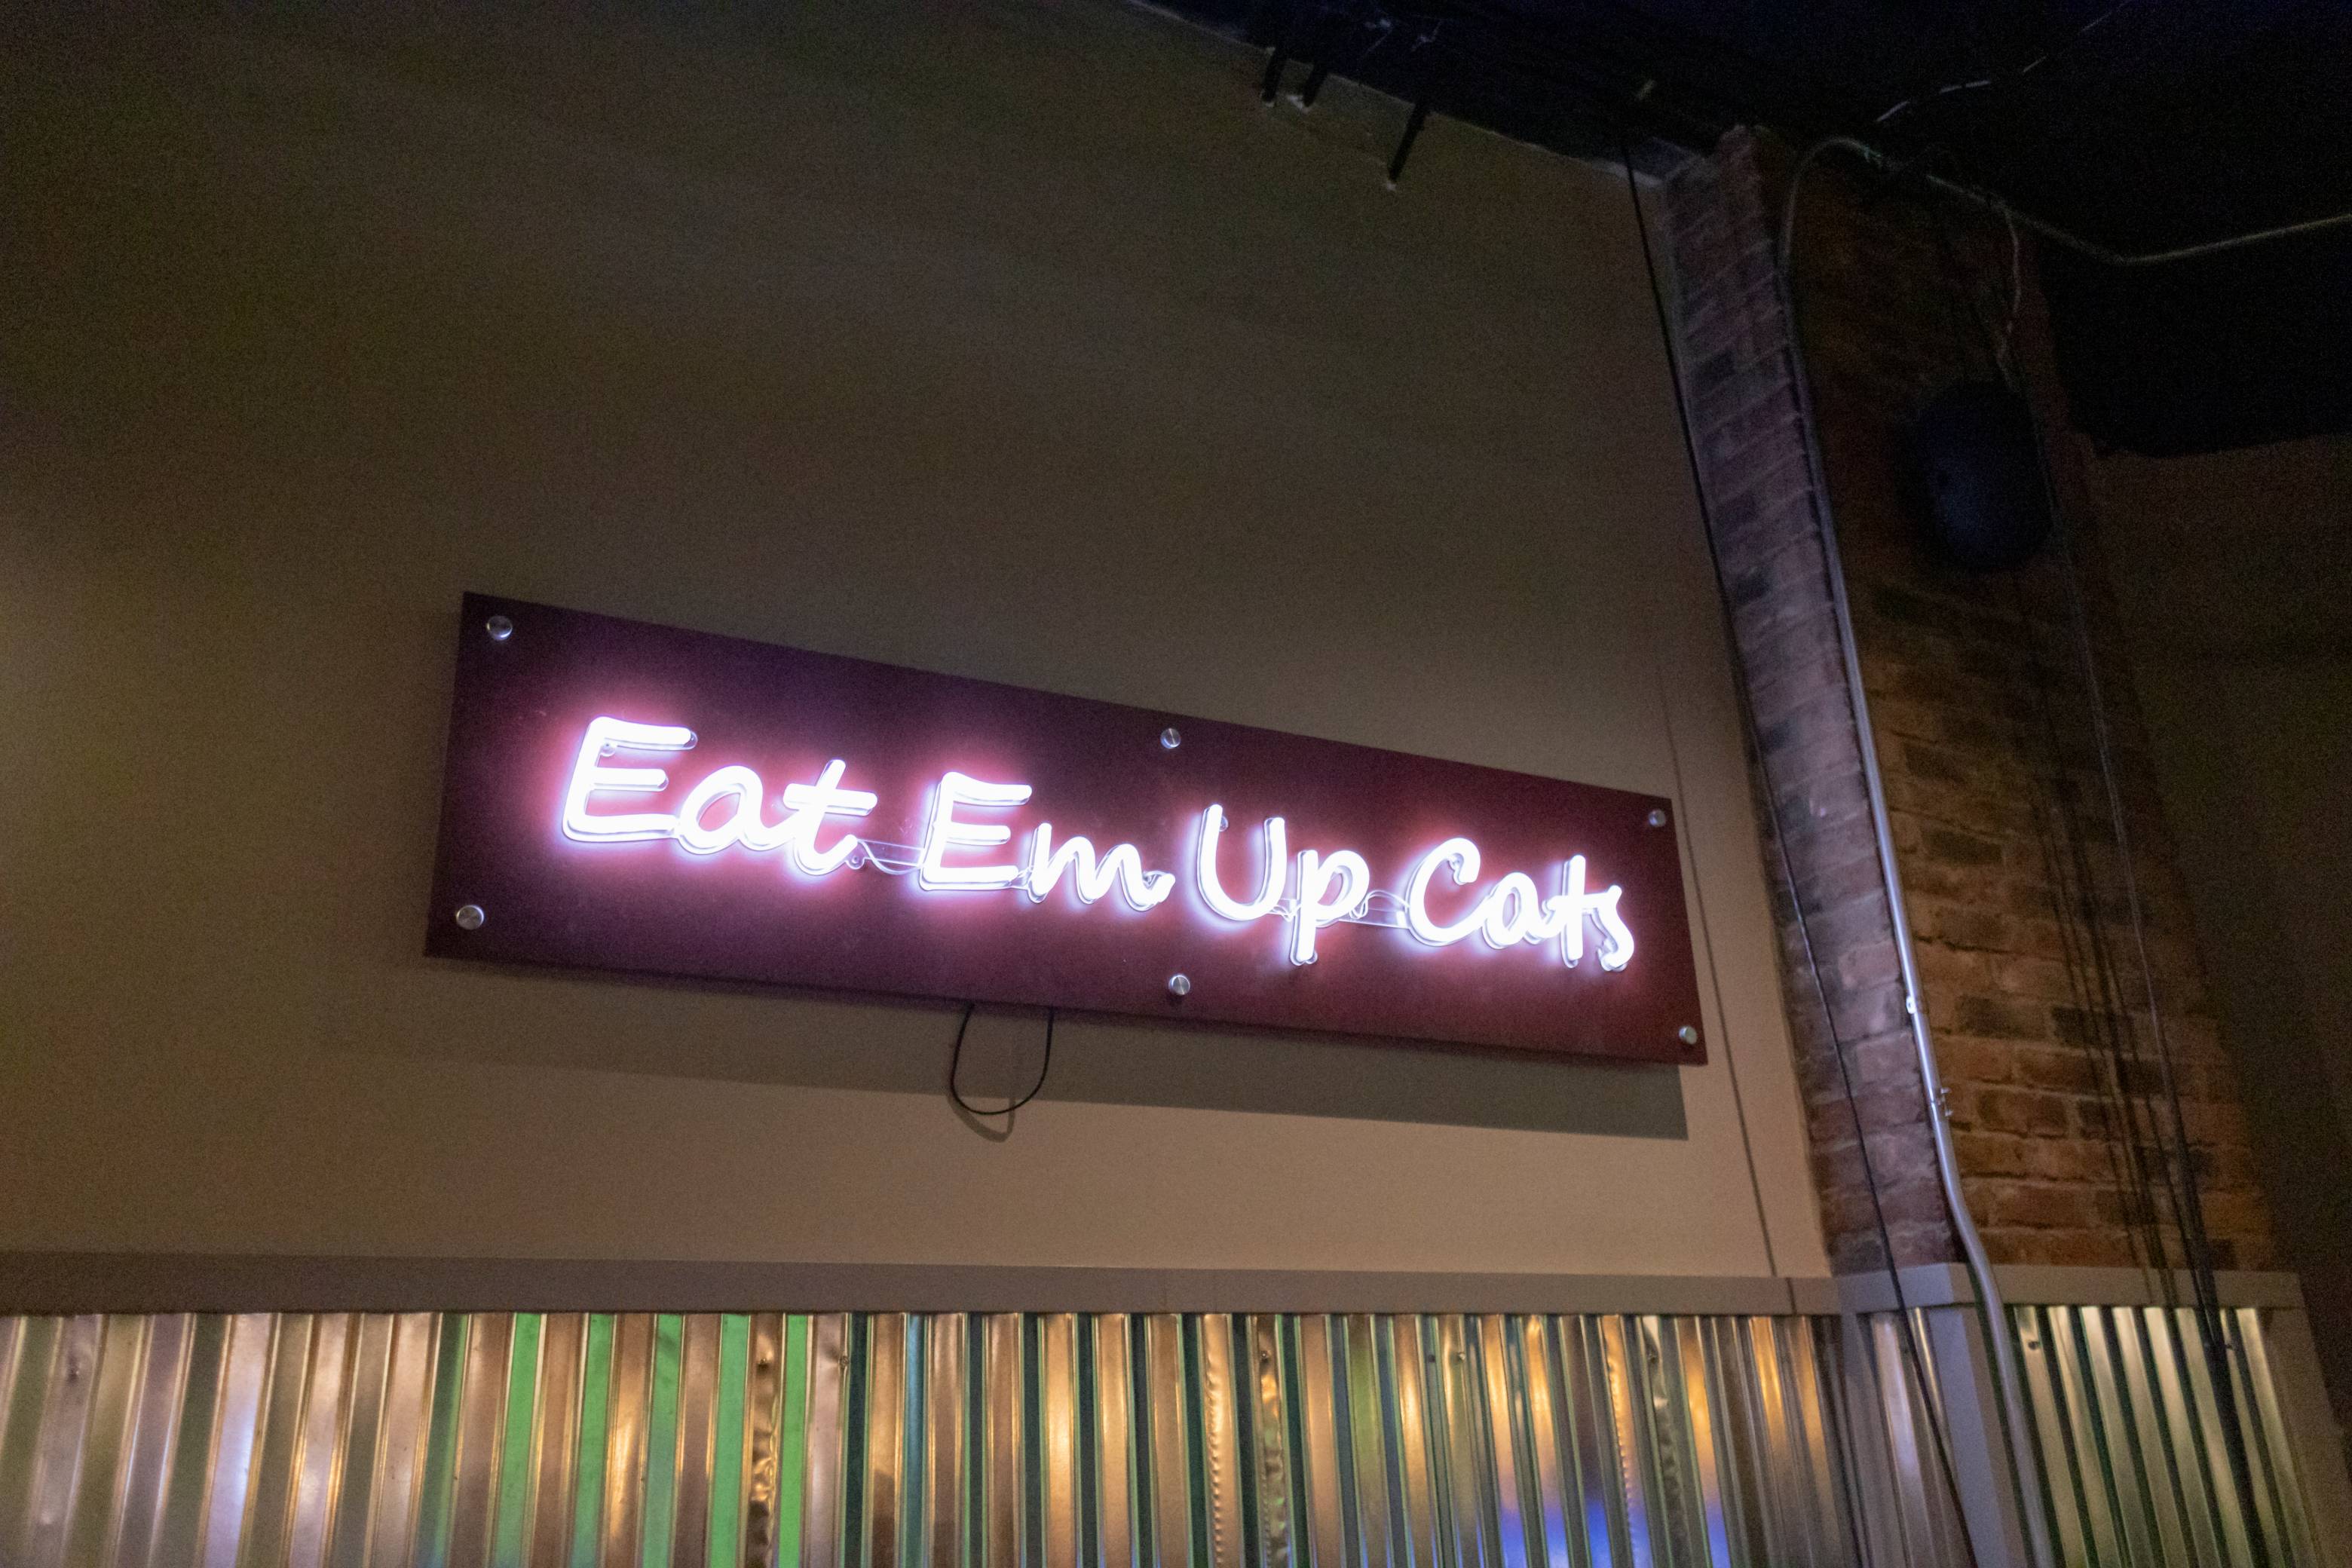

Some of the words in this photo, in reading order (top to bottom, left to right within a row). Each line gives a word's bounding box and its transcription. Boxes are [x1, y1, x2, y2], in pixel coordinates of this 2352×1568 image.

[562, 716, 877, 875] Eat
[919, 771, 1176, 911] Em
[1197, 804, 1370, 965] Up
[1406, 838, 1635, 972] Cats
